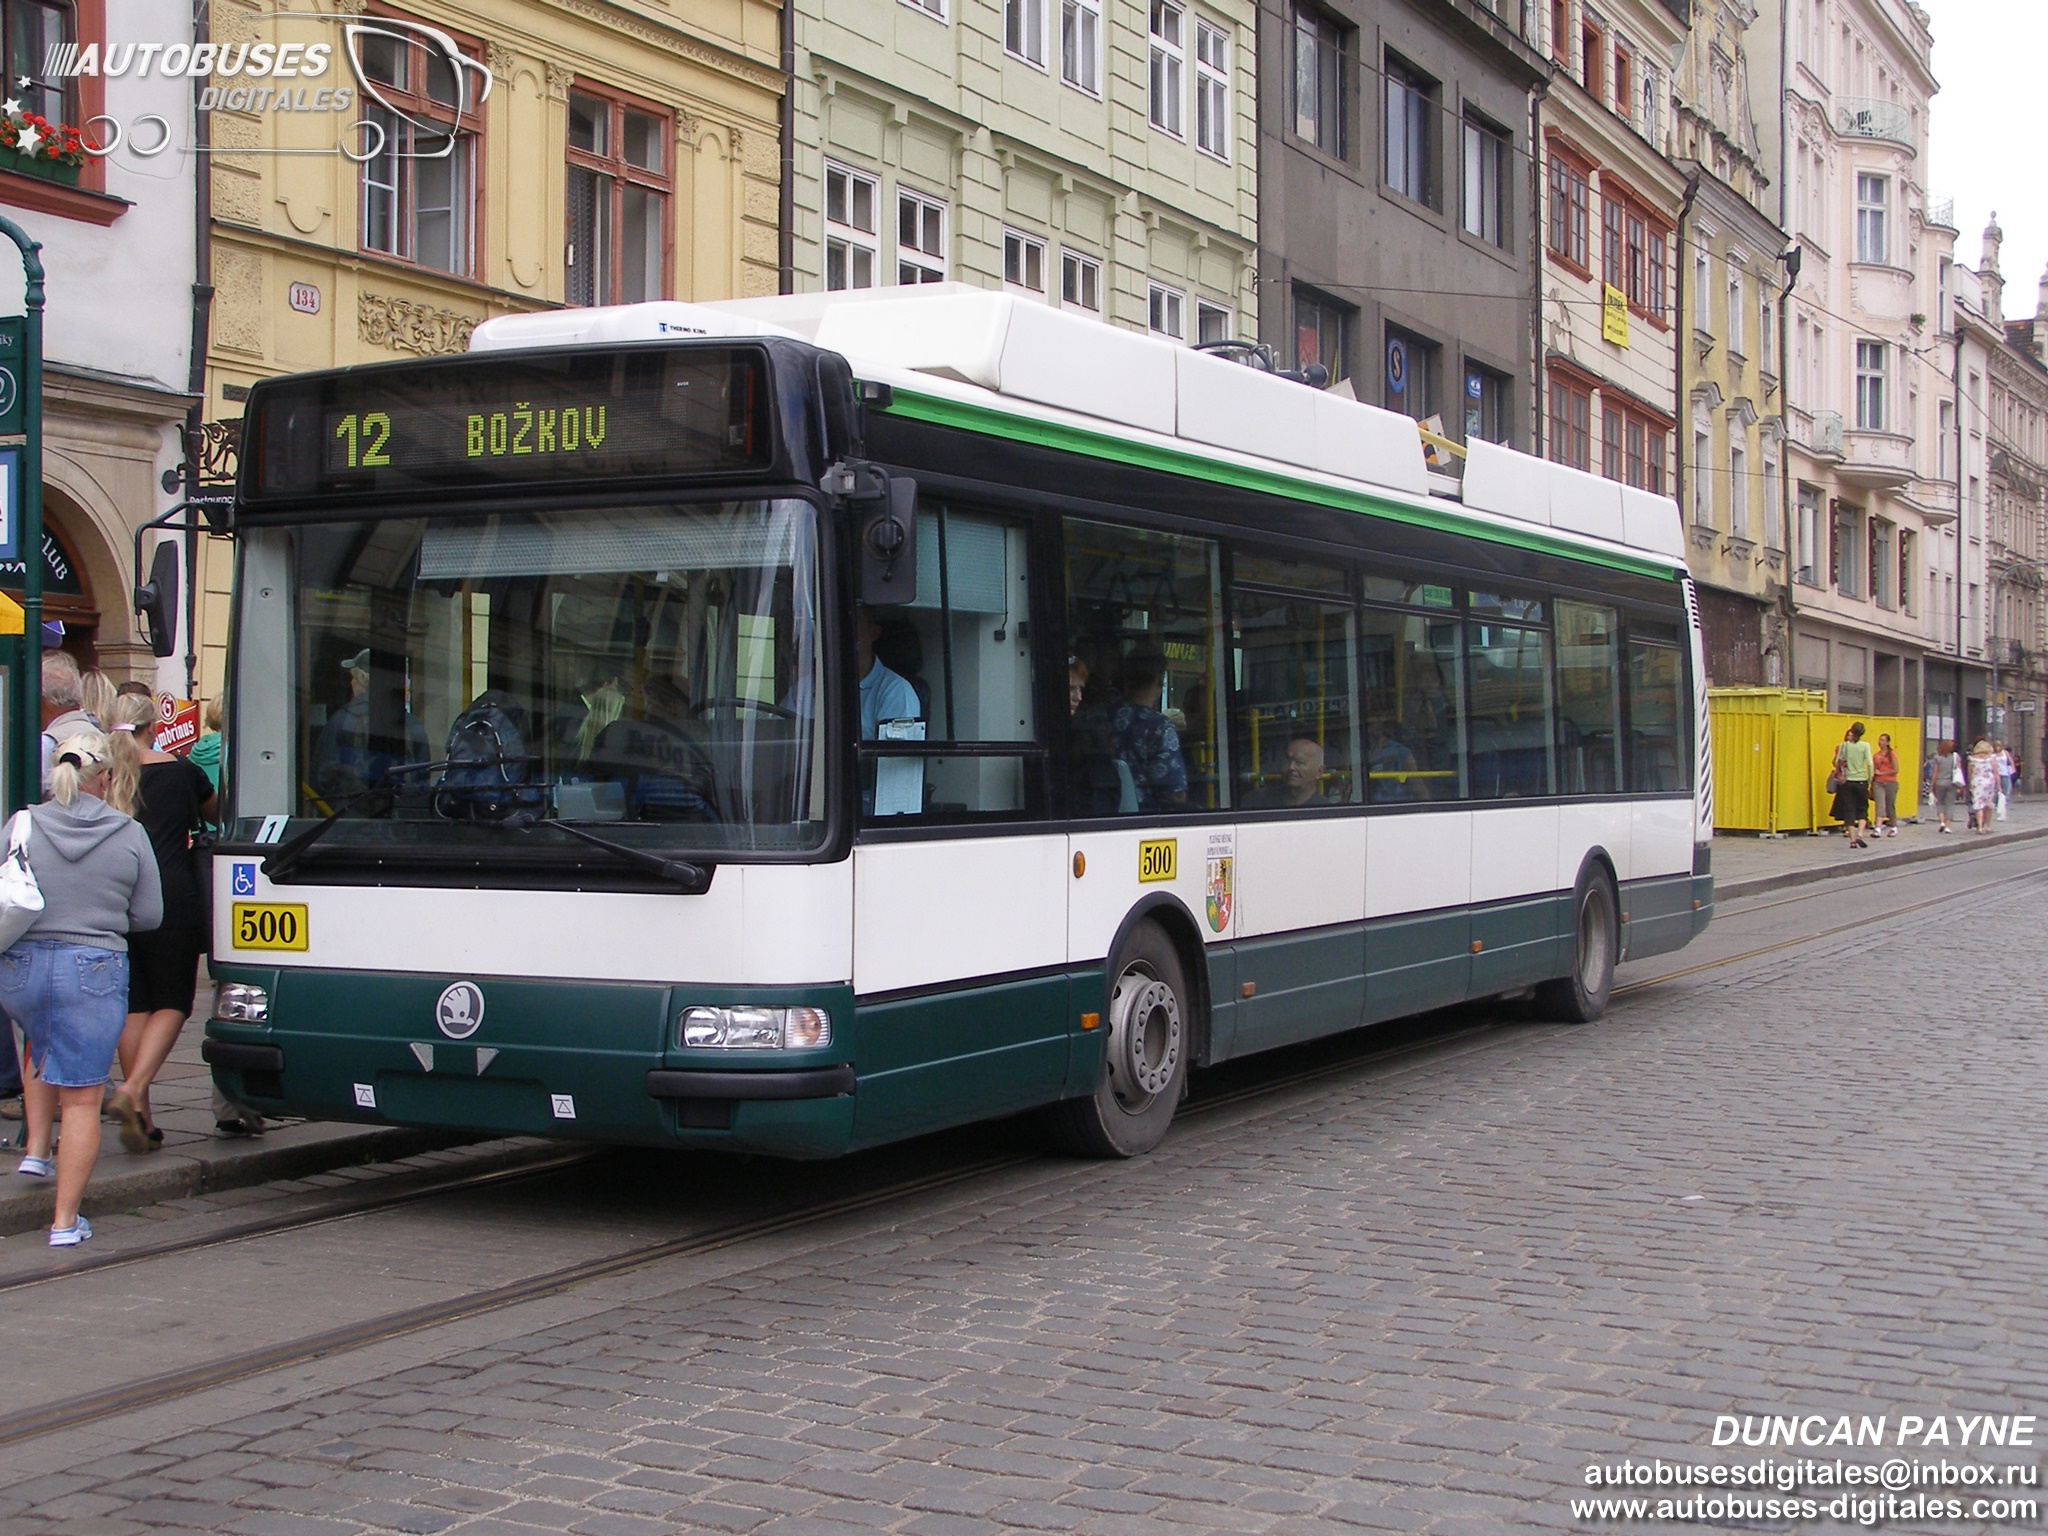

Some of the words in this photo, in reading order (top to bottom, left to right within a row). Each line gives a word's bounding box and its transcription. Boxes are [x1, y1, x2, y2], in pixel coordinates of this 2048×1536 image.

[295, 289, 316, 309] 134
[336, 412, 391, 467] 12
[467, 402, 606, 458] BOŽKOV
[41, 533, 68, 581] LUB
[155, 720, 195, 748] mbrinus
[265, 821, 278, 843] 1
[1143, 845, 1172, 876] 500
[240, 909, 297, 943] 500
